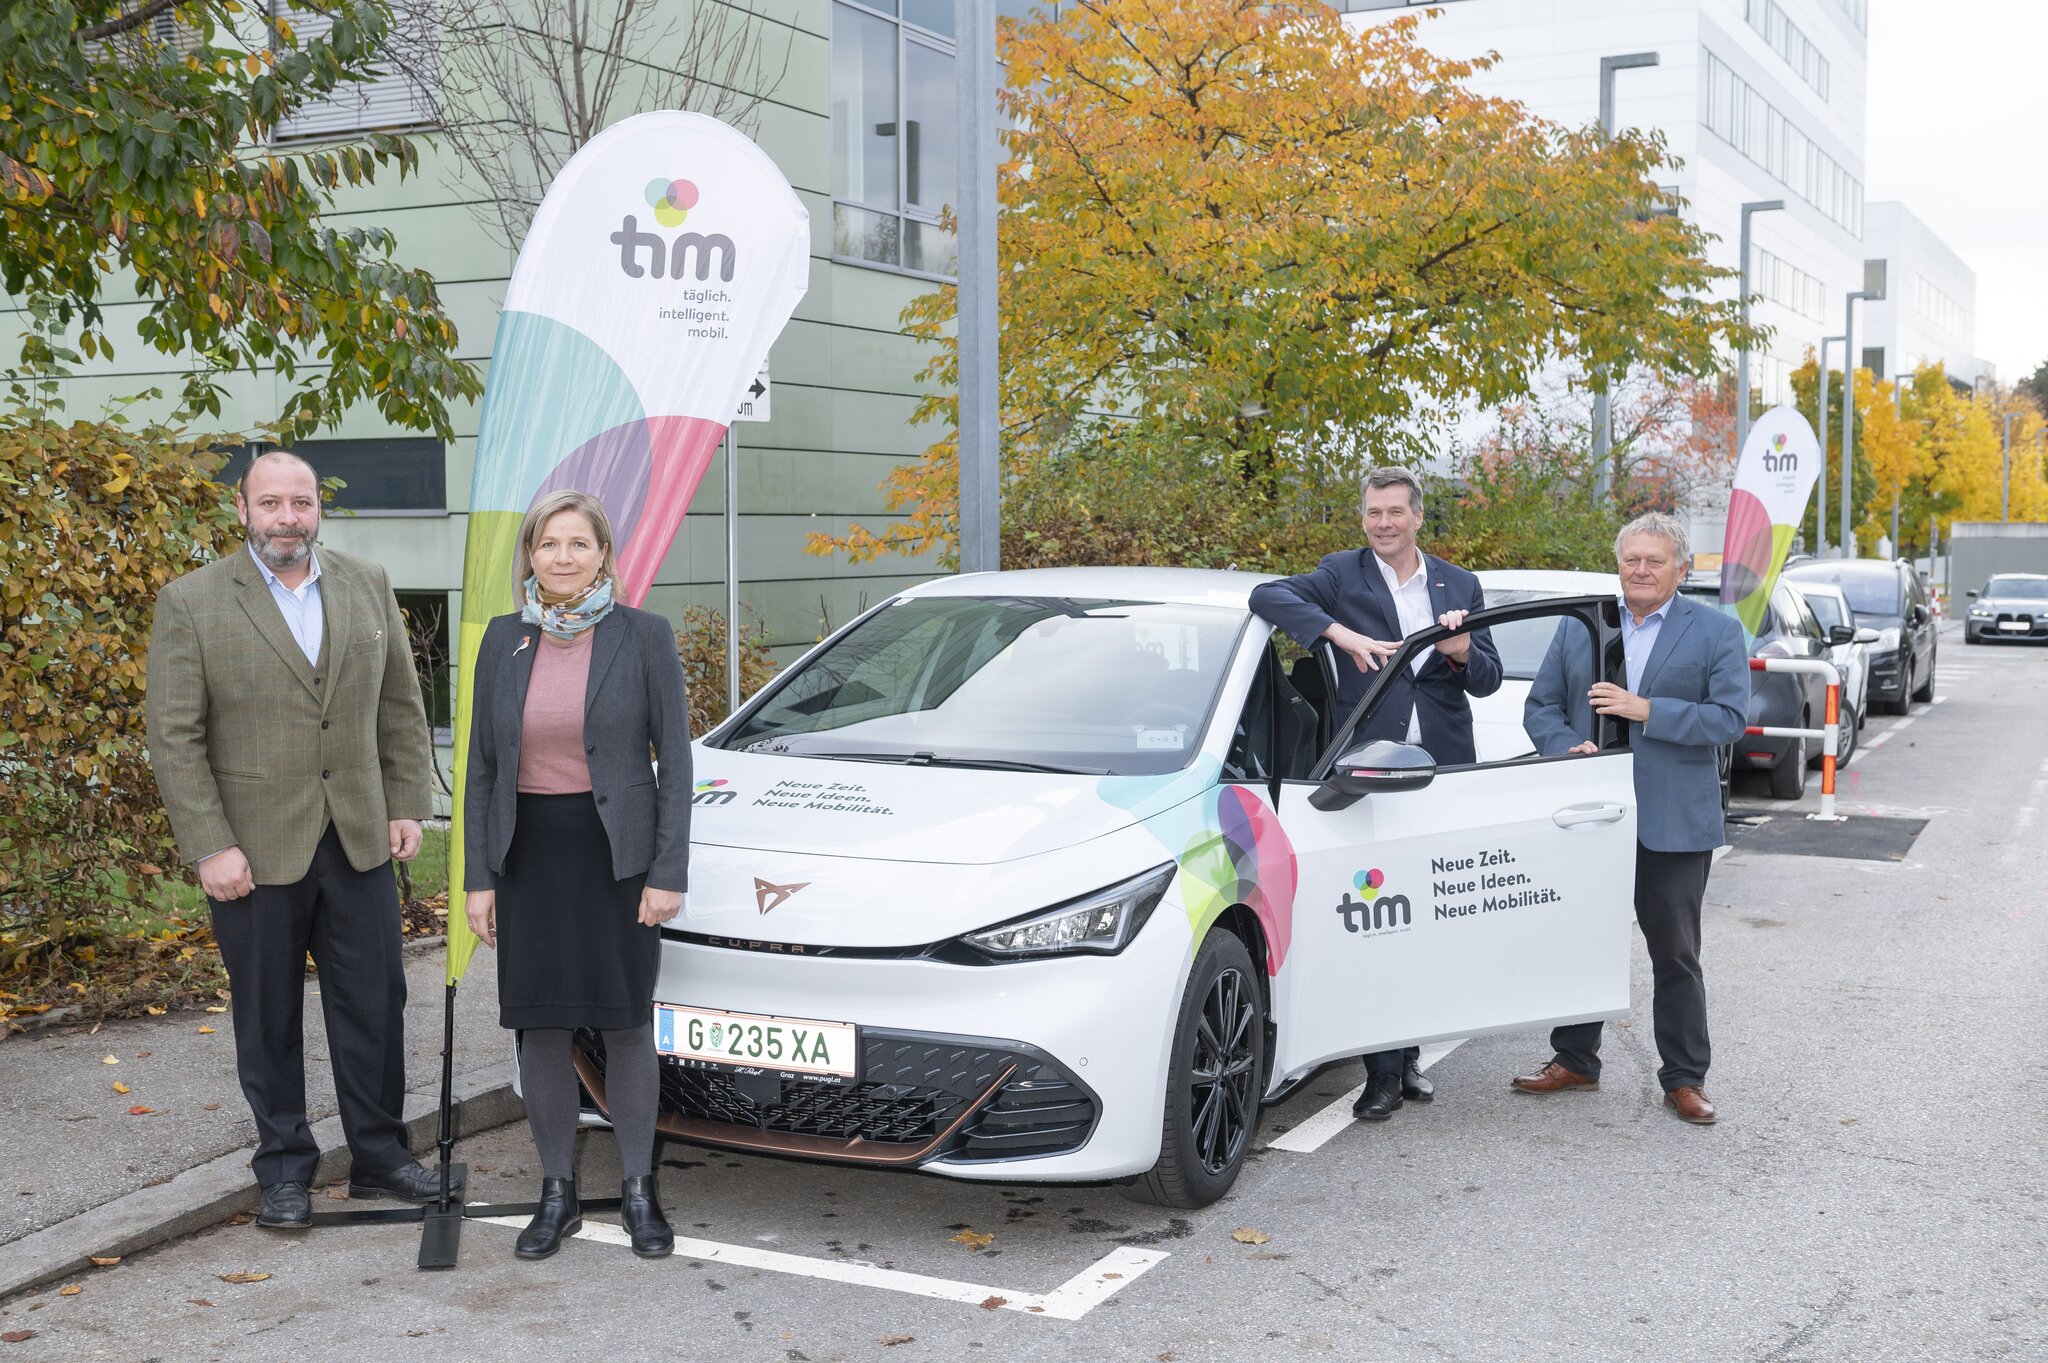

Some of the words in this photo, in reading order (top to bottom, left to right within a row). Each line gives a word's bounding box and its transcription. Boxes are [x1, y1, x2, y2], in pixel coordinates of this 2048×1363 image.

[610, 215, 736, 282] tim
[683, 289, 731, 304] täglich.
[658, 307, 730, 323] intelligent.
[688, 327, 728, 339] mobil.
[1762, 449, 1797, 472] tim
[776, 780, 823, 789] Neue
[826, 783, 867, 792] Zeit.
[764, 789, 811, 798] Neue
[816, 792, 871, 802] Ideen.
[752, 798, 800, 808] Neue
[803, 801, 894, 815] Mobilität.
[1431, 857, 1474, 874] Neue
[1479, 849, 1516, 867] Zeit.
[1433, 880, 1476, 897] Neue
[1481, 873, 1531, 890] Ideen.
[1435, 903, 1477, 920] Neue
[1482, 888, 1561, 912] Mobilität.
[1336, 893, 1411, 933] tim
[708, 936, 804, 953] CUPRA
[662, 1035, 670, 1046] A
[688, 1018, 703, 1051] G
[780, 1071, 795, 1079] Graz
[803, 1075, 841, 1084] www.pugl.at
